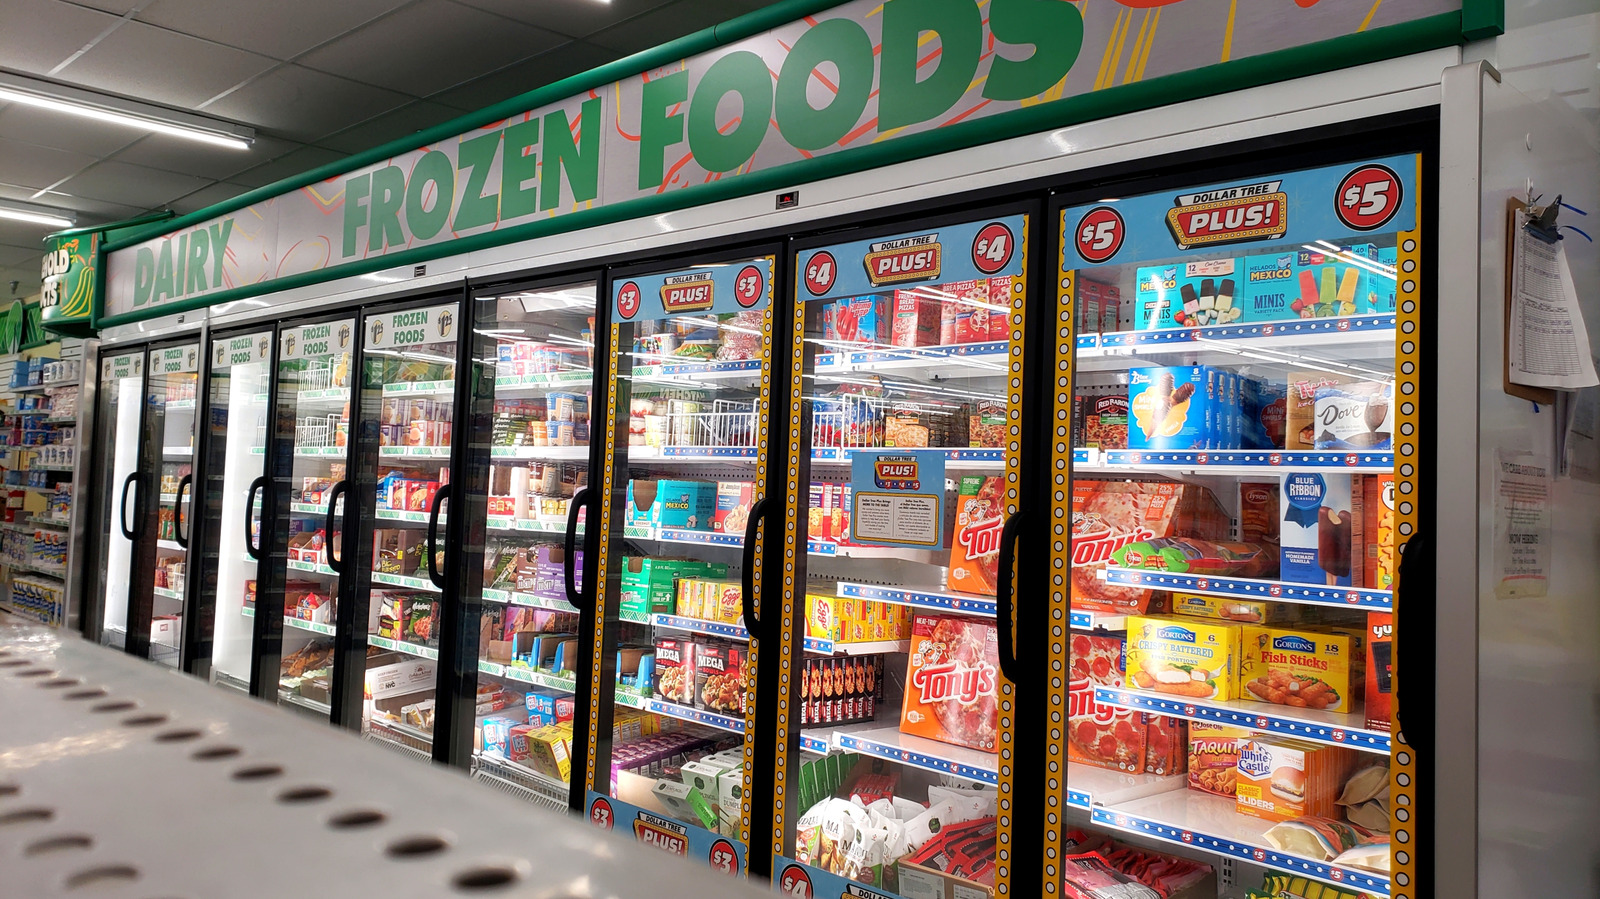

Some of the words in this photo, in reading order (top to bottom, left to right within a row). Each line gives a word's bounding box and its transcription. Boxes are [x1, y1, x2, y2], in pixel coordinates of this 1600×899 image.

[637, 0, 1084, 191] FOODS
[340, 97, 601, 258] FROZEN
[1193, 188, 1237, 204] DOLLAR
[1240, 184, 1270, 197] TREE
[1343, 179, 1391, 216] $5
[1188, 202, 1273, 234] PLUS!
[881, 238, 907, 250] DOLLAR
[909, 236, 931, 246] TREE
[1082, 220, 1117, 250] $5
[976, 236, 1007, 262] $4
[133, 218, 234, 307] DAIRY
[877, 252, 932, 276] PLUS!
[672, 274, 690, 284] DOLLAR
[692, 272, 708, 281] TREE
[808, 262, 831, 286] $4
[992, 278, 1012, 286] PIZZAS
[1250, 268, 1292, 282] MEXICO
[738, 274, 758, 298] $3
[957, 282, 976, 290] PIZZAS
[1140, 280, 1176, 292] MECO
[620, 291, 635, 310] $3
[670, 285, 709, 305] PLUS!
[1254, 294, 1285, 309] MINIS
[392, 311, 428, 328] FROZEN
[1262, 326, 1272, 334] $5
[1338, 320, 1348, 329] $5
[302, 325, 330, 340] FROZEN
[394, 329, 425, 345] FOODS
[230, 337, 253, 350] FROZEN
[304, 341, 328, 355] FOODS
[230, 352, 251, 364] FOODS
[1098, 400, 1109, 408] RED
[1317, 404, 1362, 426] Dove
[1270, 455, 1280, 464] $5
[1346, 454, 1356, 464] $5
[882, 466, 914, 476] PLUS!
[1290, 484, 1321, 498] RIBBON
[722, 588, 740, 606] Eggo
[1271, 586, 1280, 596] $5
[1347, 593, 1358, 602] $5
[817, 600, 830, 630] Eggo
[656, 648, 680, 663] MEGA
[1138, 640, 1167, 652] CRISPY
[1170, 644, 1214, 658] BATTERED
[1324, 644, 1339, 652] 18
[698, 655, 724, 672] MEGA
[1260, 650, 1287, 664] Fish
[1290, 654, 1328, 670] Sticks
[914, 661, 995, 704] Tony's
[1258, 717, 1267, 726] $5
[1333, 730, 1343, 740] $5
[1191, 740, 1238, 755] TAQUIT
[1242, 750, 1268, 762] White
[1239, 760, 1270, 772] Castle
[1237, 794, 1274, 810] SLIDERS
[593, 806, 610, 830] $3
[646, 816, 667, 828] DOLLAR
[668, 822, 682, 832] TREE
[643, 830, 683, 855] PLUS!
[714, 850, 733, 874] $3
[1254, 850, 1264, 860] $5
[1331, 870, 1341, 879] $5
[784, 874, 808, 899] $4
